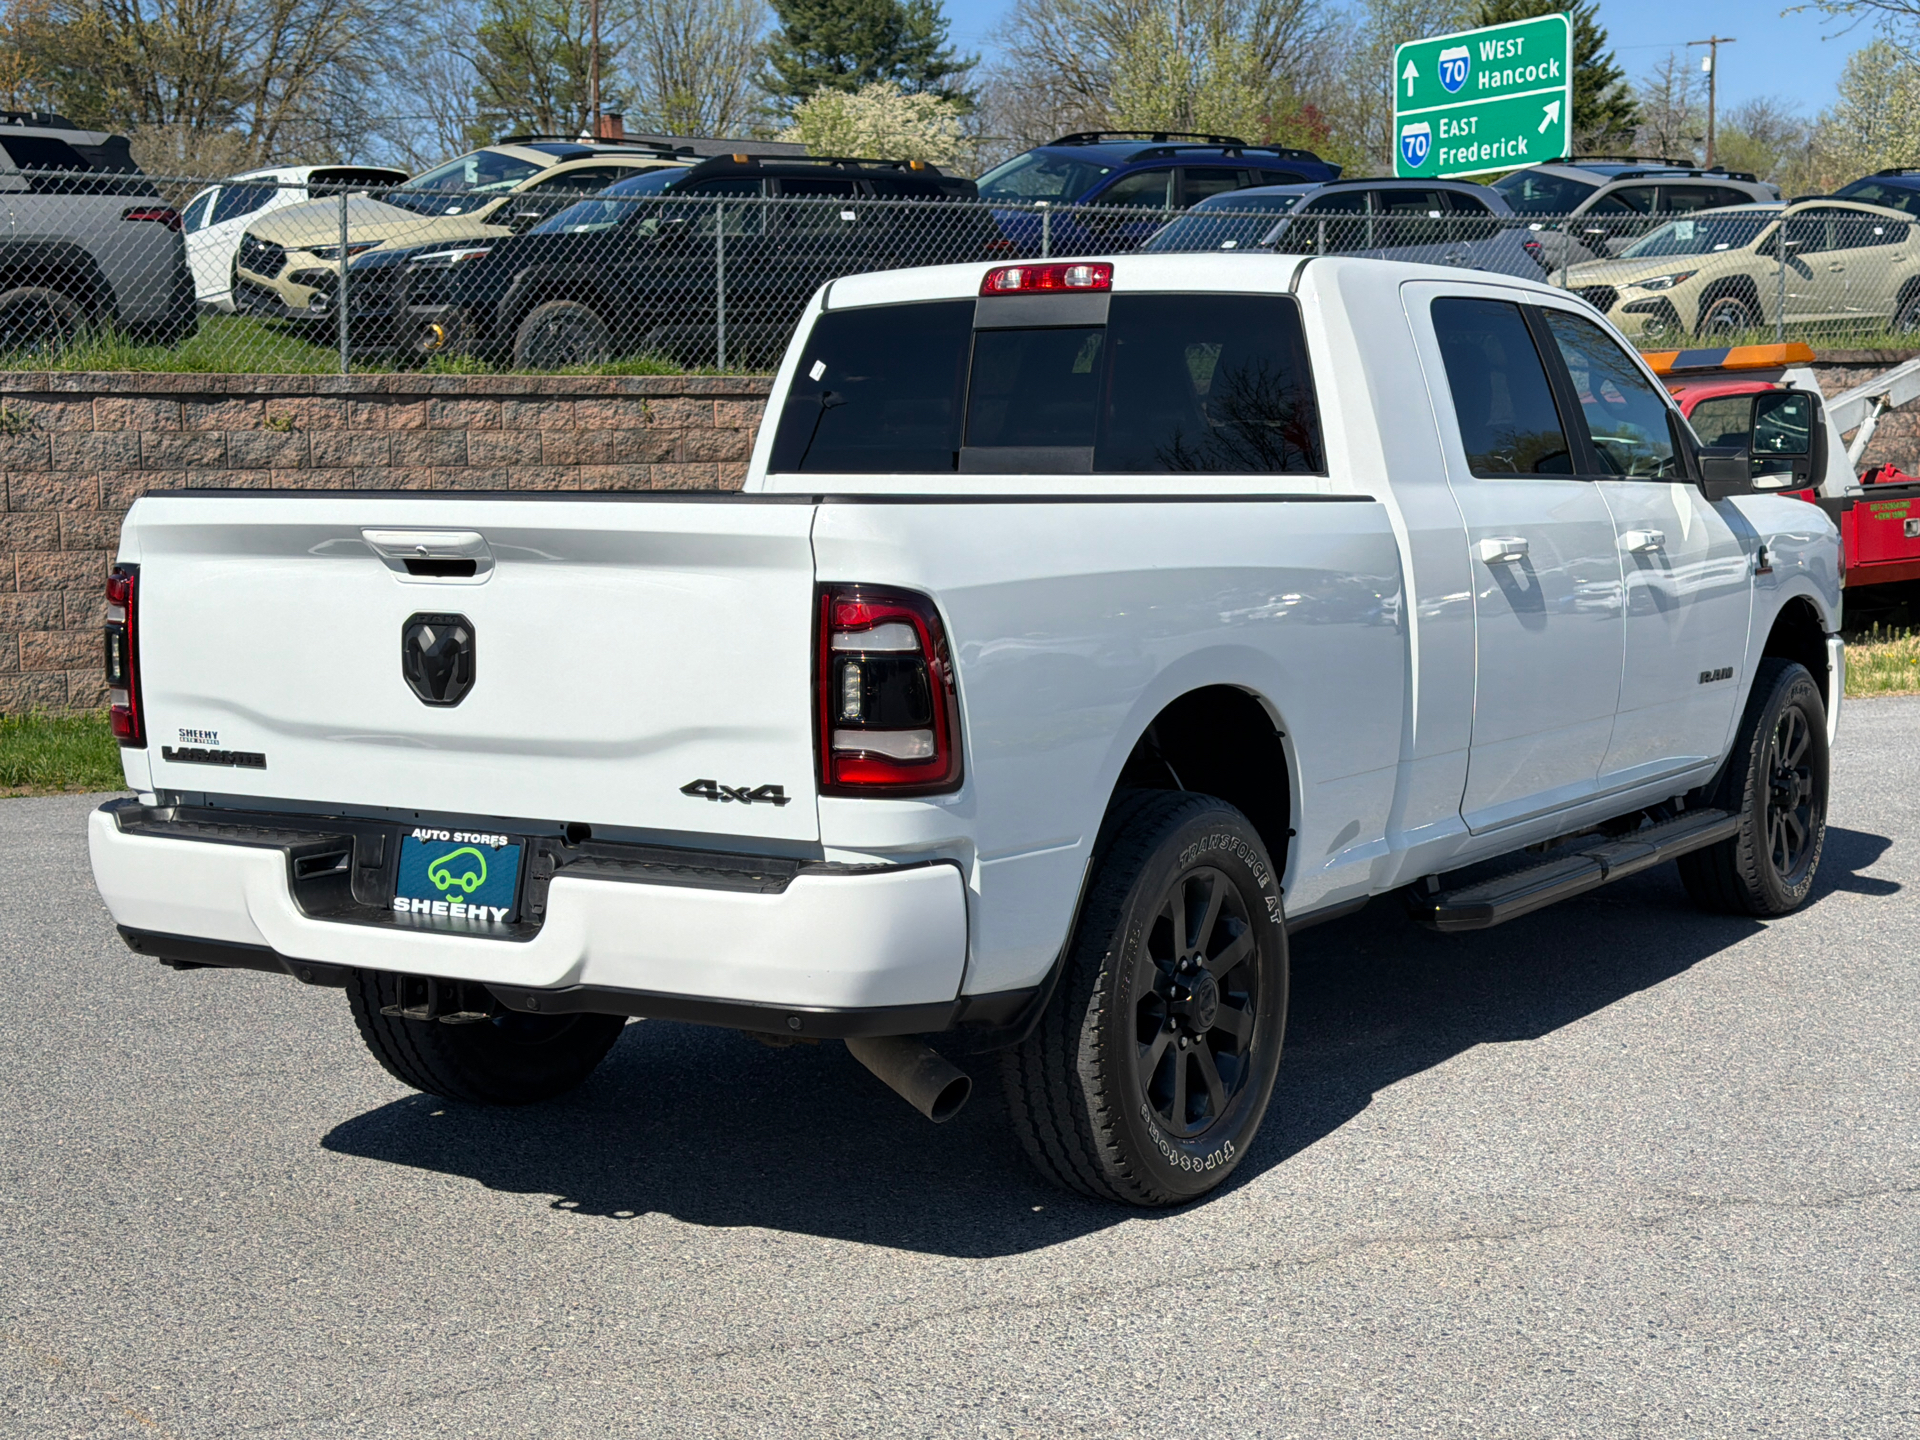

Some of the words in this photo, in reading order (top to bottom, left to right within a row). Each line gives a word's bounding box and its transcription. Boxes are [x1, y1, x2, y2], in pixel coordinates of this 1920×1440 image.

[1479, 38, 1525, 61] WEST
[1443, 60, 1465, 83] 70
[1478, 58, 1560, 89] Hancock
[1440, 117, 1478, 138] EAST
[1405, 135, 1427, 158] 70
[1439, 135, 1528, 166] Frederick
[1698, 666, 1734, 685] RAM
[178, 728, 219, 740] SHEEHY
[161, 745, 268, 770] LARAMIE
[411, 828, 450, 841] AUTO
[453, 832, 508, 846] STORES
[1178, 833, 1271, 889] TRANSFORCE
[1264, 895, 1282, 925] AT
[393, 897, 510, 922] SHEEHY
